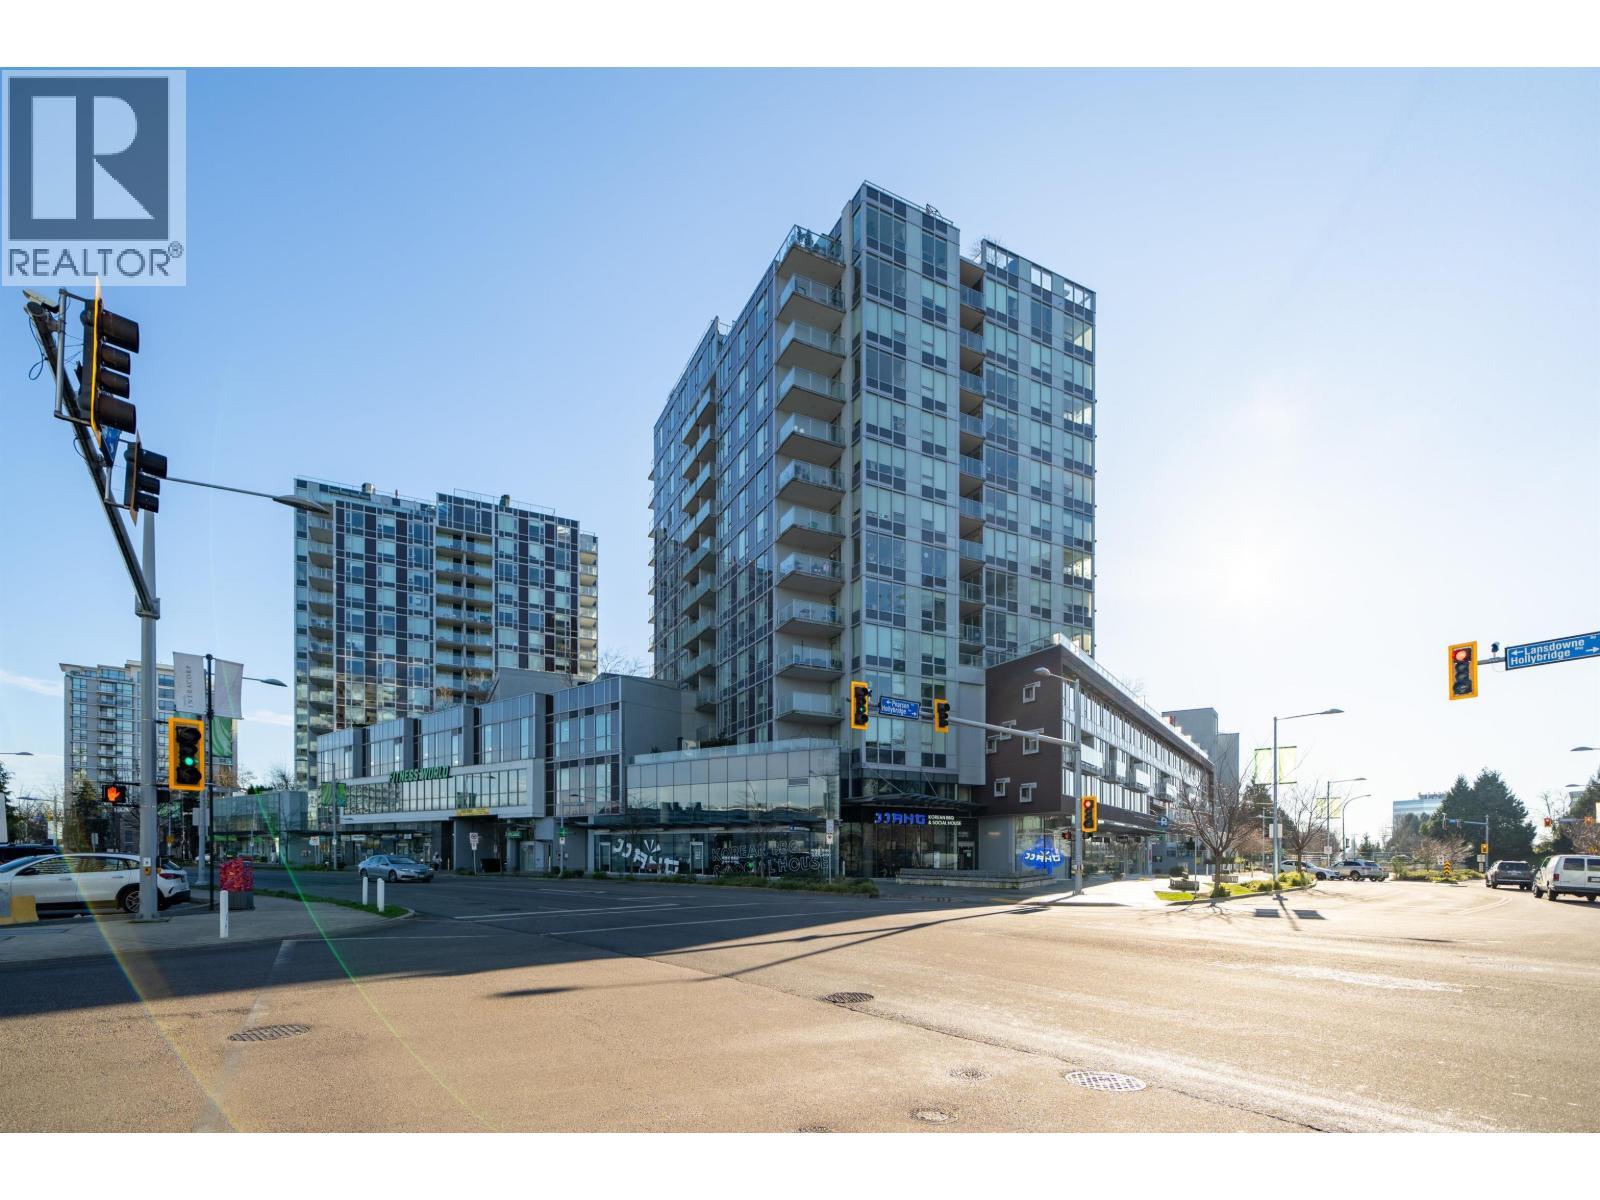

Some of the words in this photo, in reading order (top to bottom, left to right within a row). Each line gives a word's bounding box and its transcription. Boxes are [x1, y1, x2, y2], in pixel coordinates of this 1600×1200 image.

[1524, 639, 1585, 655] Lansdowne
[1510, 649, 1571, 666] Hollybridge
[390, 769, 419, 783] FITNESS
[419, 766, 449, 780] WORLD
